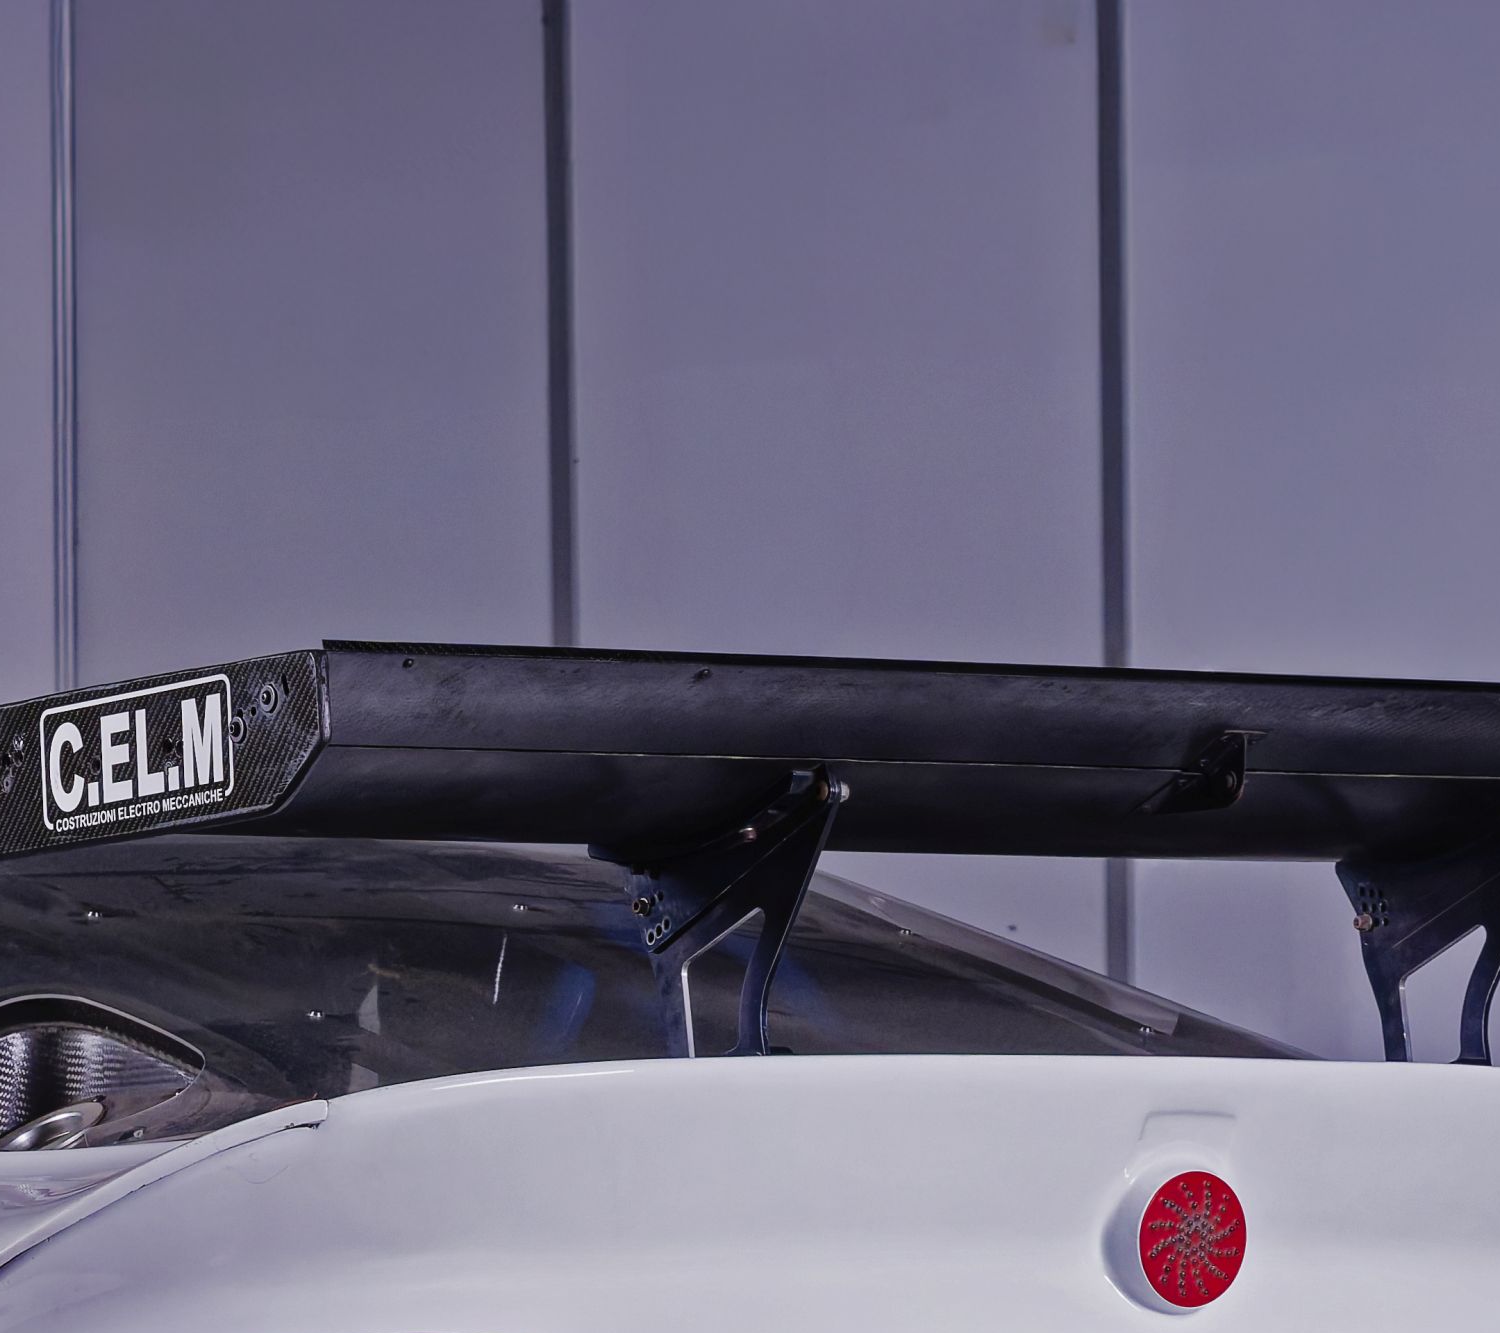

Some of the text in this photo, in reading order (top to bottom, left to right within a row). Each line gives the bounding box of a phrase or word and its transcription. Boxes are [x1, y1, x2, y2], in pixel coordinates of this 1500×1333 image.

[50, 693, 224, 813] C.EL.M
[56, 788, 224, 833] COSTRUZIONI ELECTRO MECCANICHE
